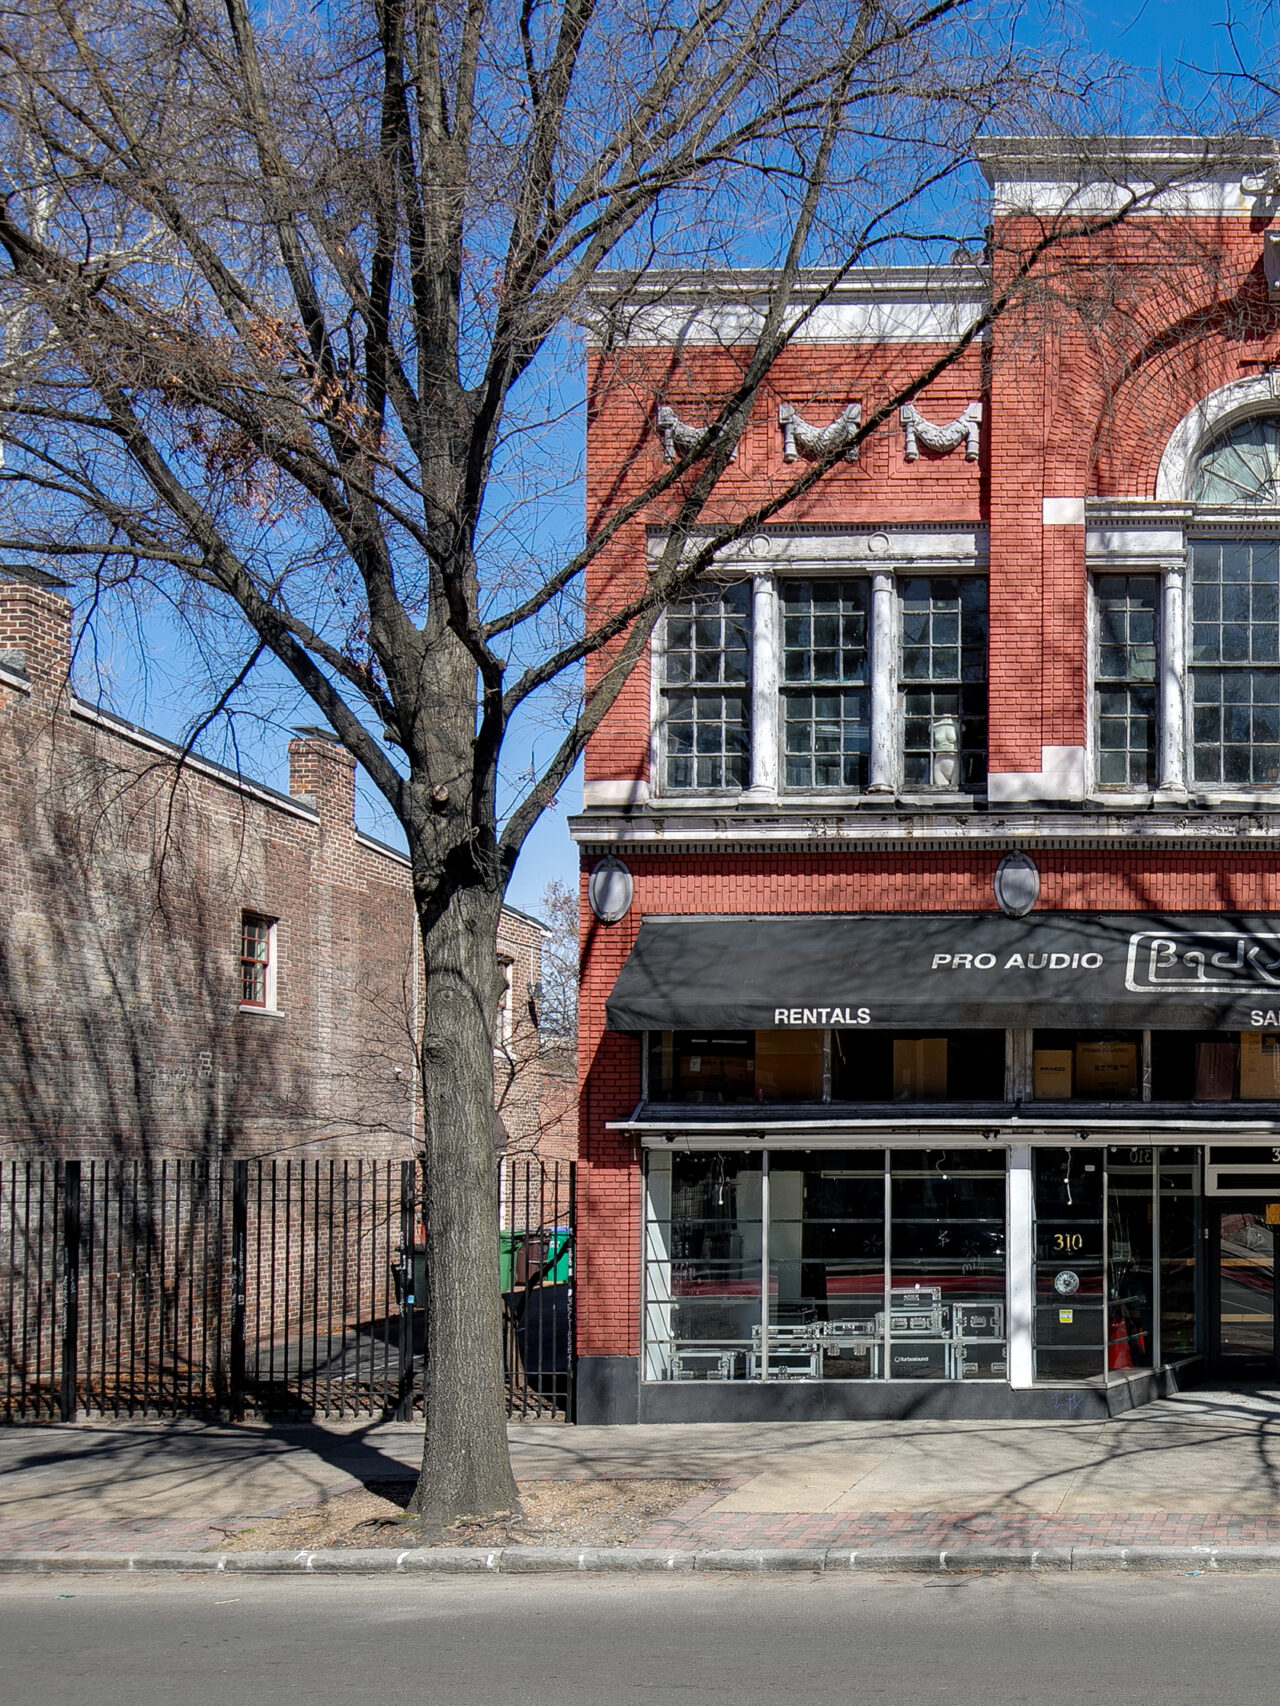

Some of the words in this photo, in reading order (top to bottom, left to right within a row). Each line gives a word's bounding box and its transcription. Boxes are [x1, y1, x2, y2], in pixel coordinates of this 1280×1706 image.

[931, 952, 997, 970] PRO
[1004, 952, 1104, 970] AUDIO
[774, 1007, 871, 1025] RENTALS
[1054, 1233, 1083, 1251] 310
